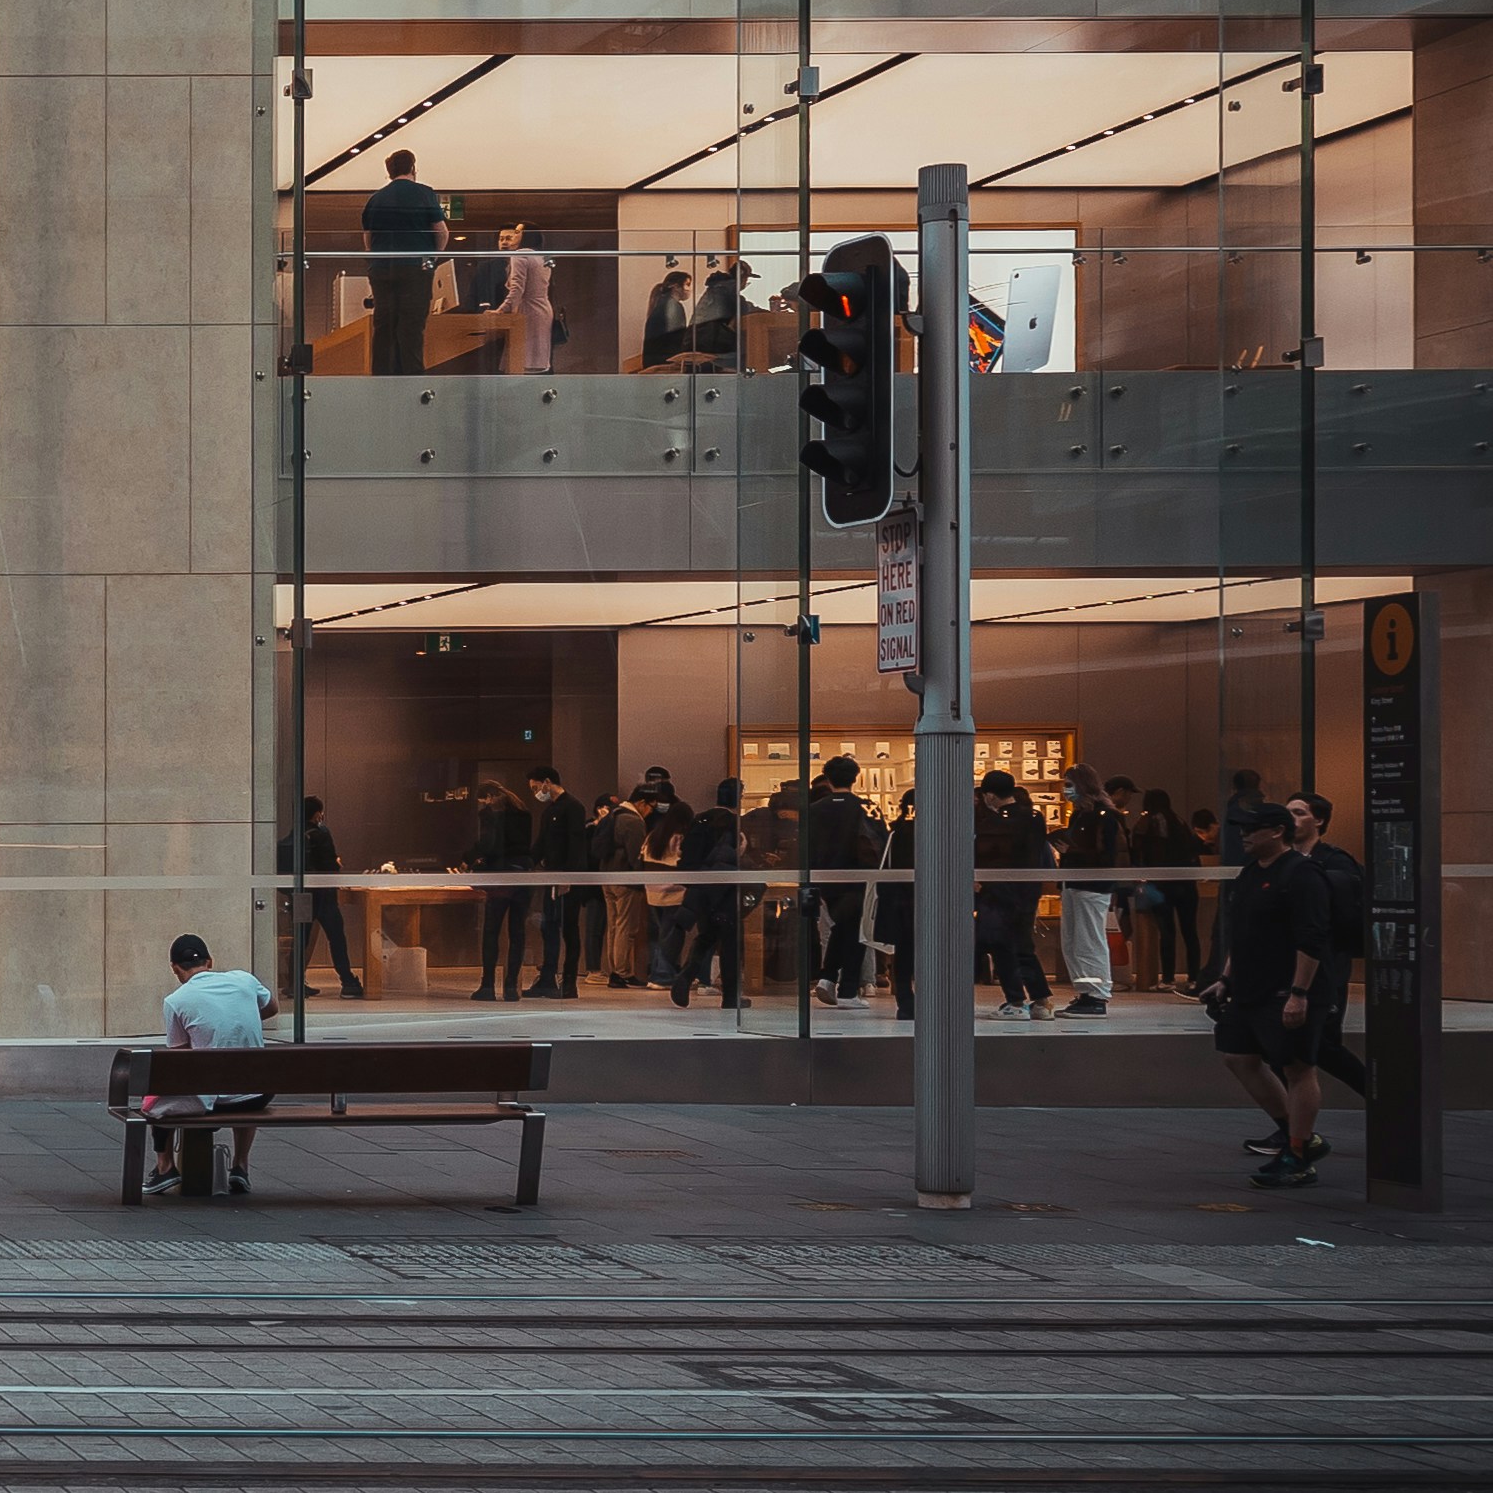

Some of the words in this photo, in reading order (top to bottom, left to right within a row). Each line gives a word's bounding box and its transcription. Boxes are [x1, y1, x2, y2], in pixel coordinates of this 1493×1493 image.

[882, 522, 912, 554] STOP
[882, 561, 913, 592] HERE
[880, 603, 894, 627] ON
[895, 600, 915, 625] RED
[880, 635, 915, 662] SIGNAL
